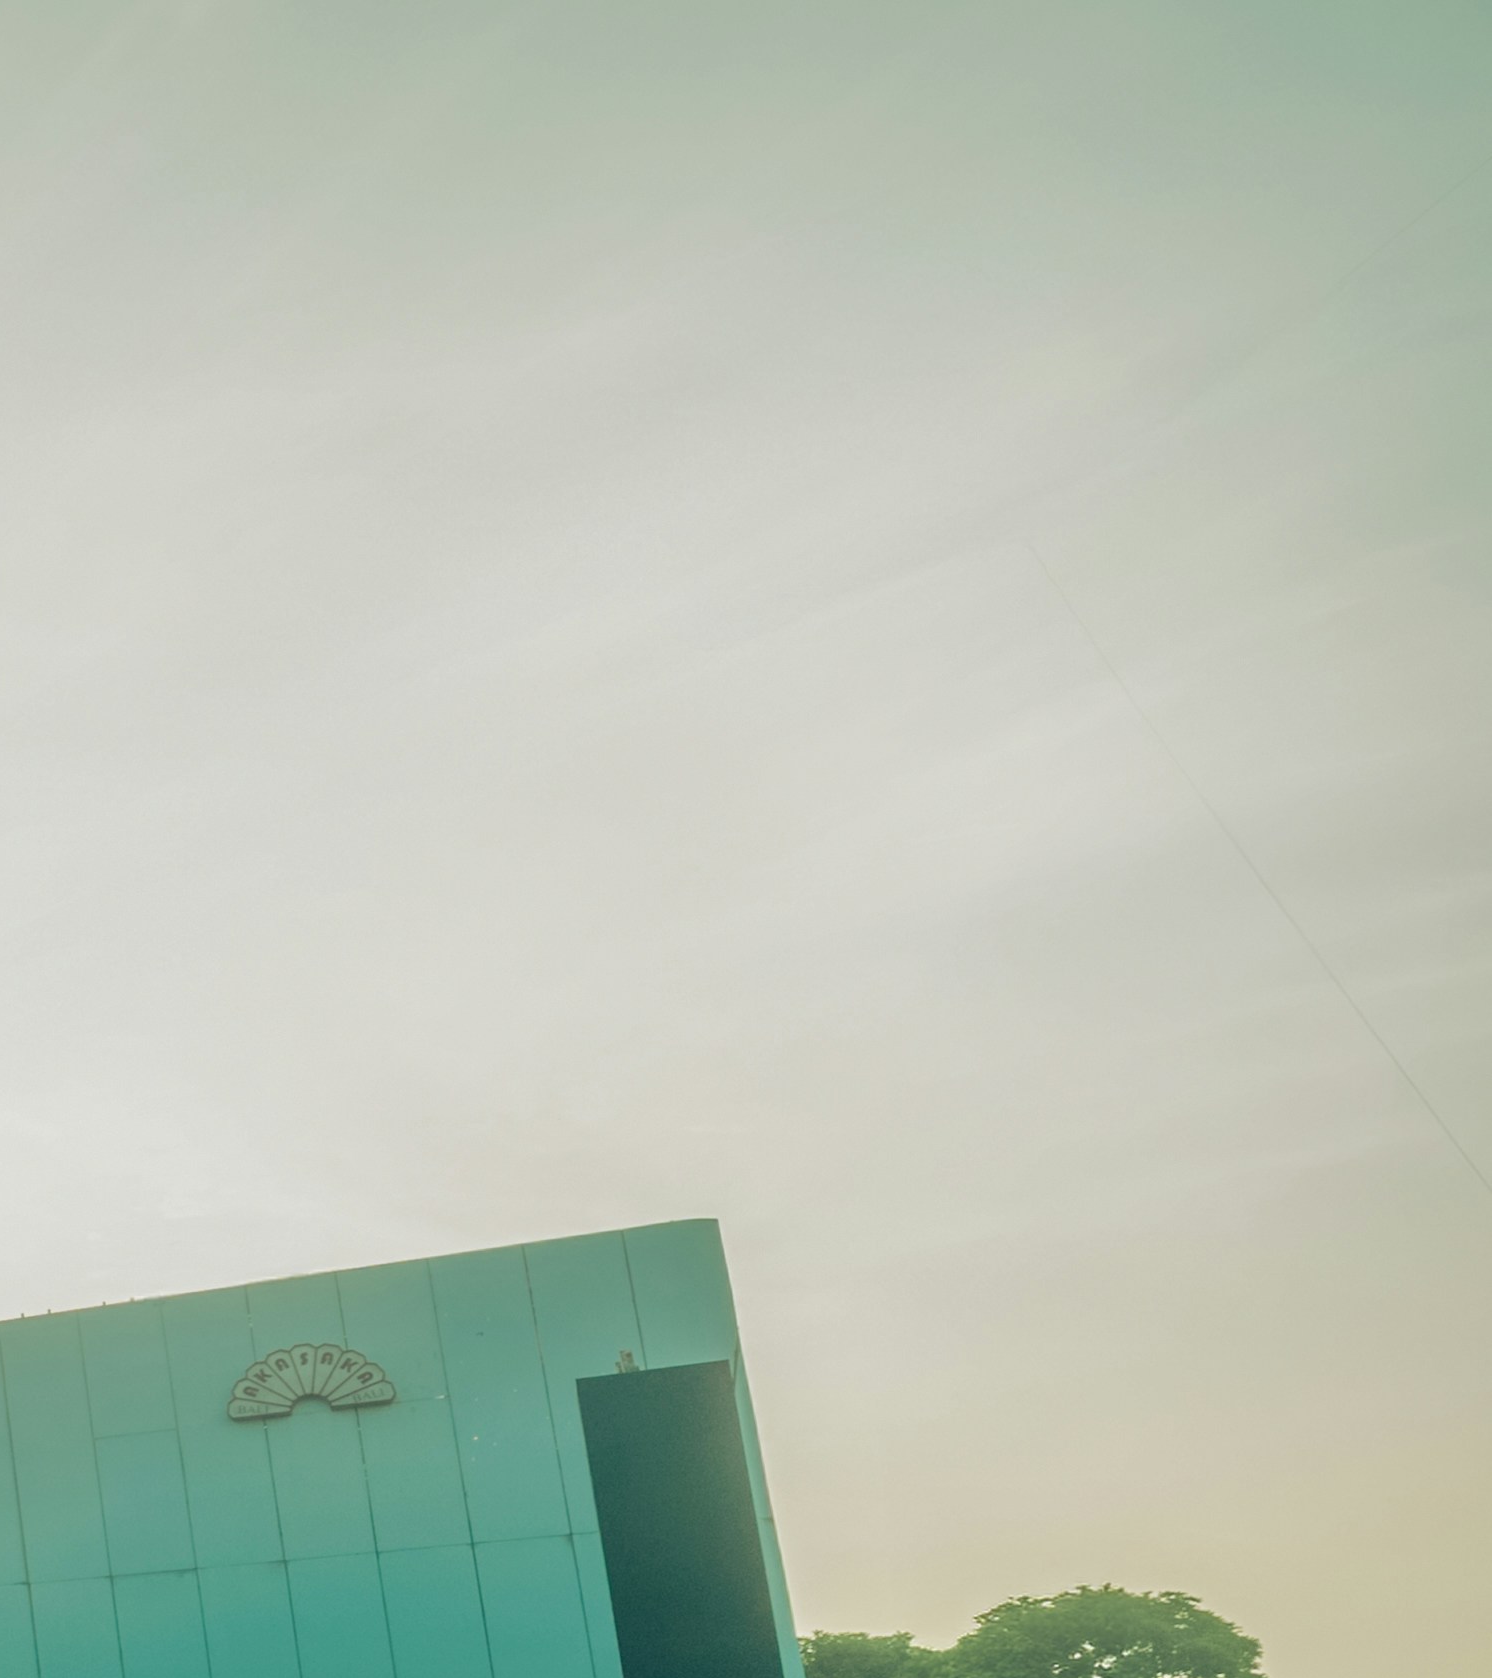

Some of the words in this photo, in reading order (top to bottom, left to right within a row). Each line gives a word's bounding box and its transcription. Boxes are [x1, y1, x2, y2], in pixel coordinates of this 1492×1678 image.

[241, 1351, 374, 1398] AKASAKA
[352, 1386, 387, 1402] BALI
[236, 1403, 271, 1415] BALI
